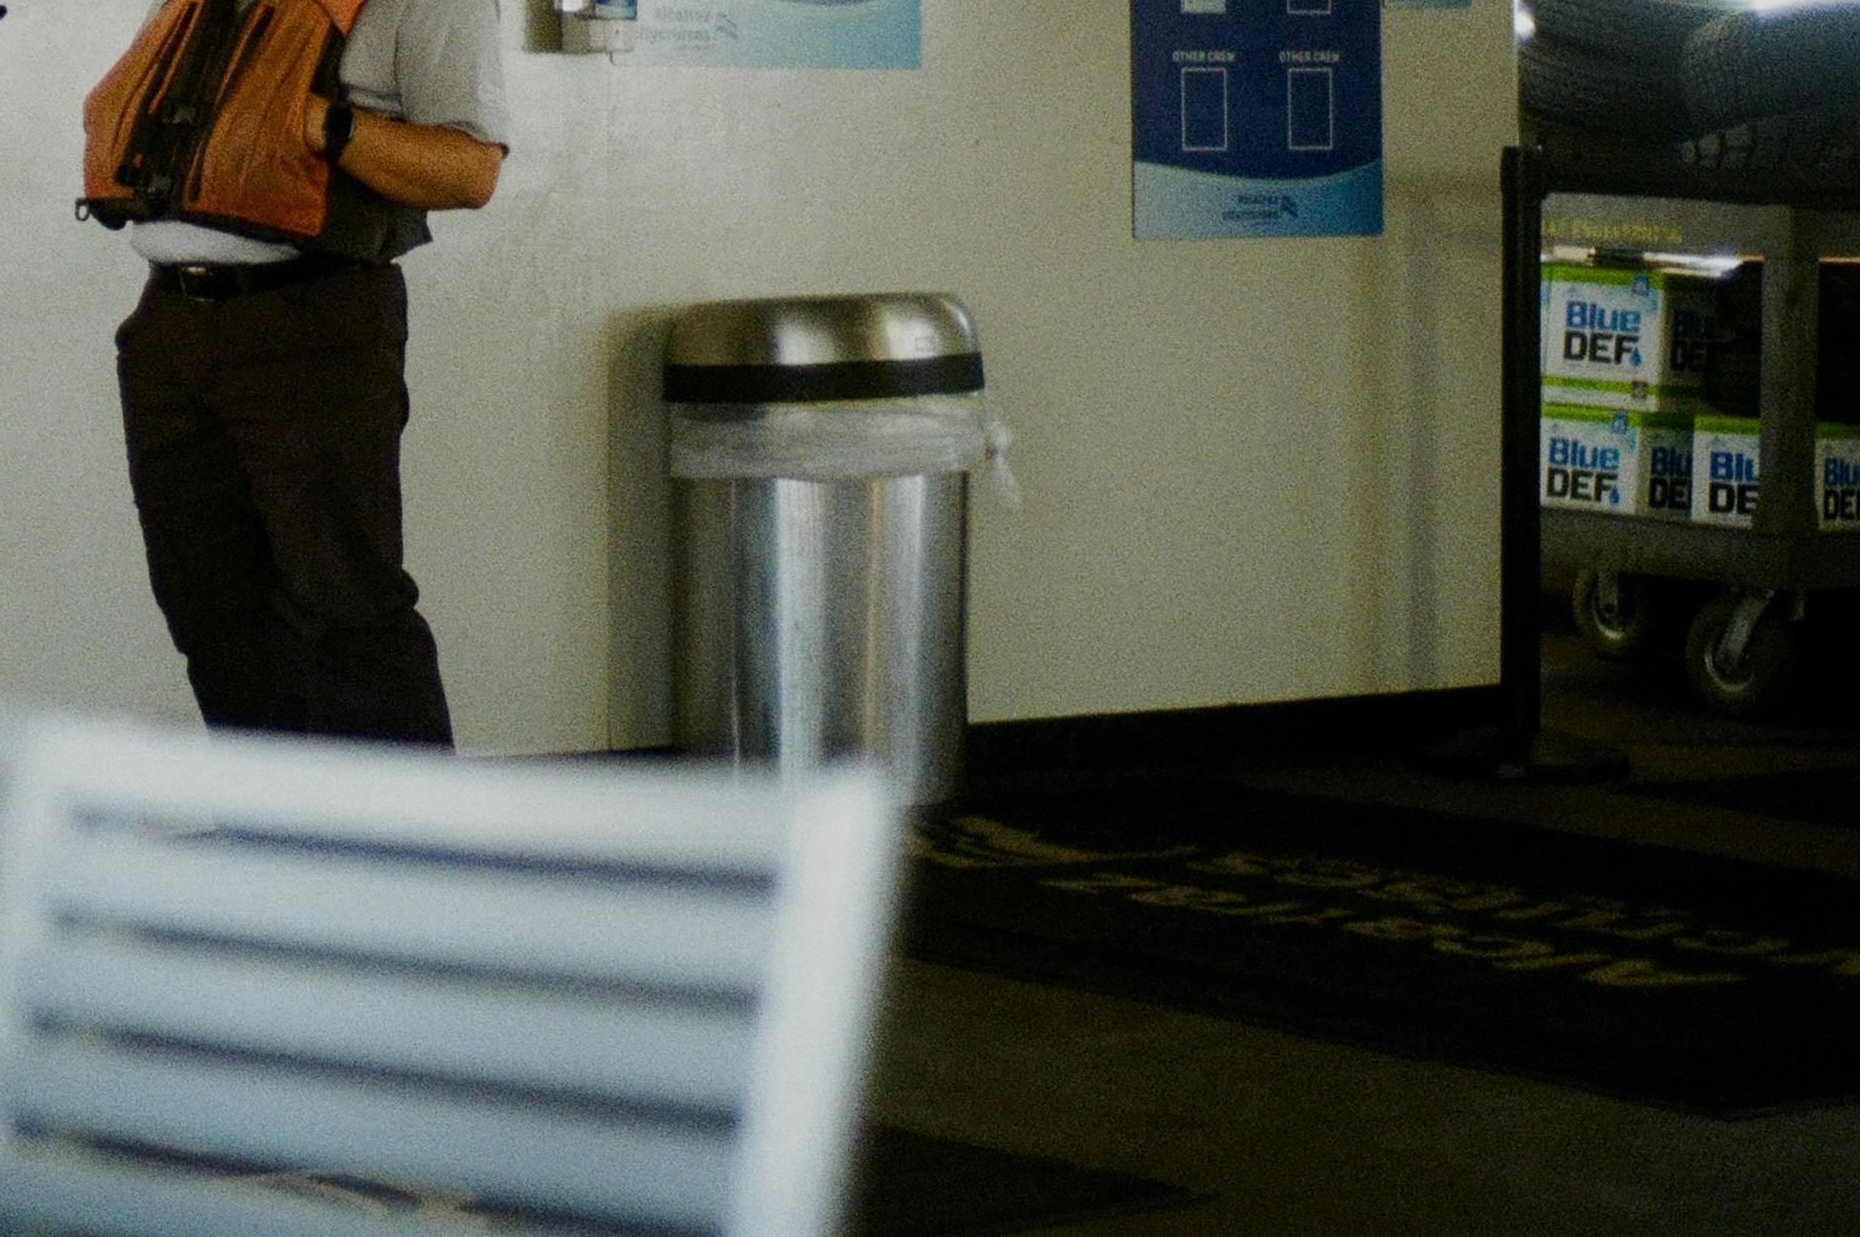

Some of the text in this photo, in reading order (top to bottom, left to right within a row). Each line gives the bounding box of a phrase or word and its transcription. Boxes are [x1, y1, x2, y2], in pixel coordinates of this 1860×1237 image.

[1172, 49, 1237, 63] OTHER CREW
[1278, 49, 1342, 63] OTHER CREW
[1566, 300, 1641, 333] Blue
[1563, 329, 1640, 364] DEF
[1548, 437, 1620, 471] Blue
[1651, 446, 1692, 477] Blu
[1547, 466, 1619, 502] DEF
[1824, 457, 1860, 487] Blu
[1648, 477, 1692, 510] DE
[1708, 481, 1759, 514] DE
[1824, 490, 1860, 521] DE
